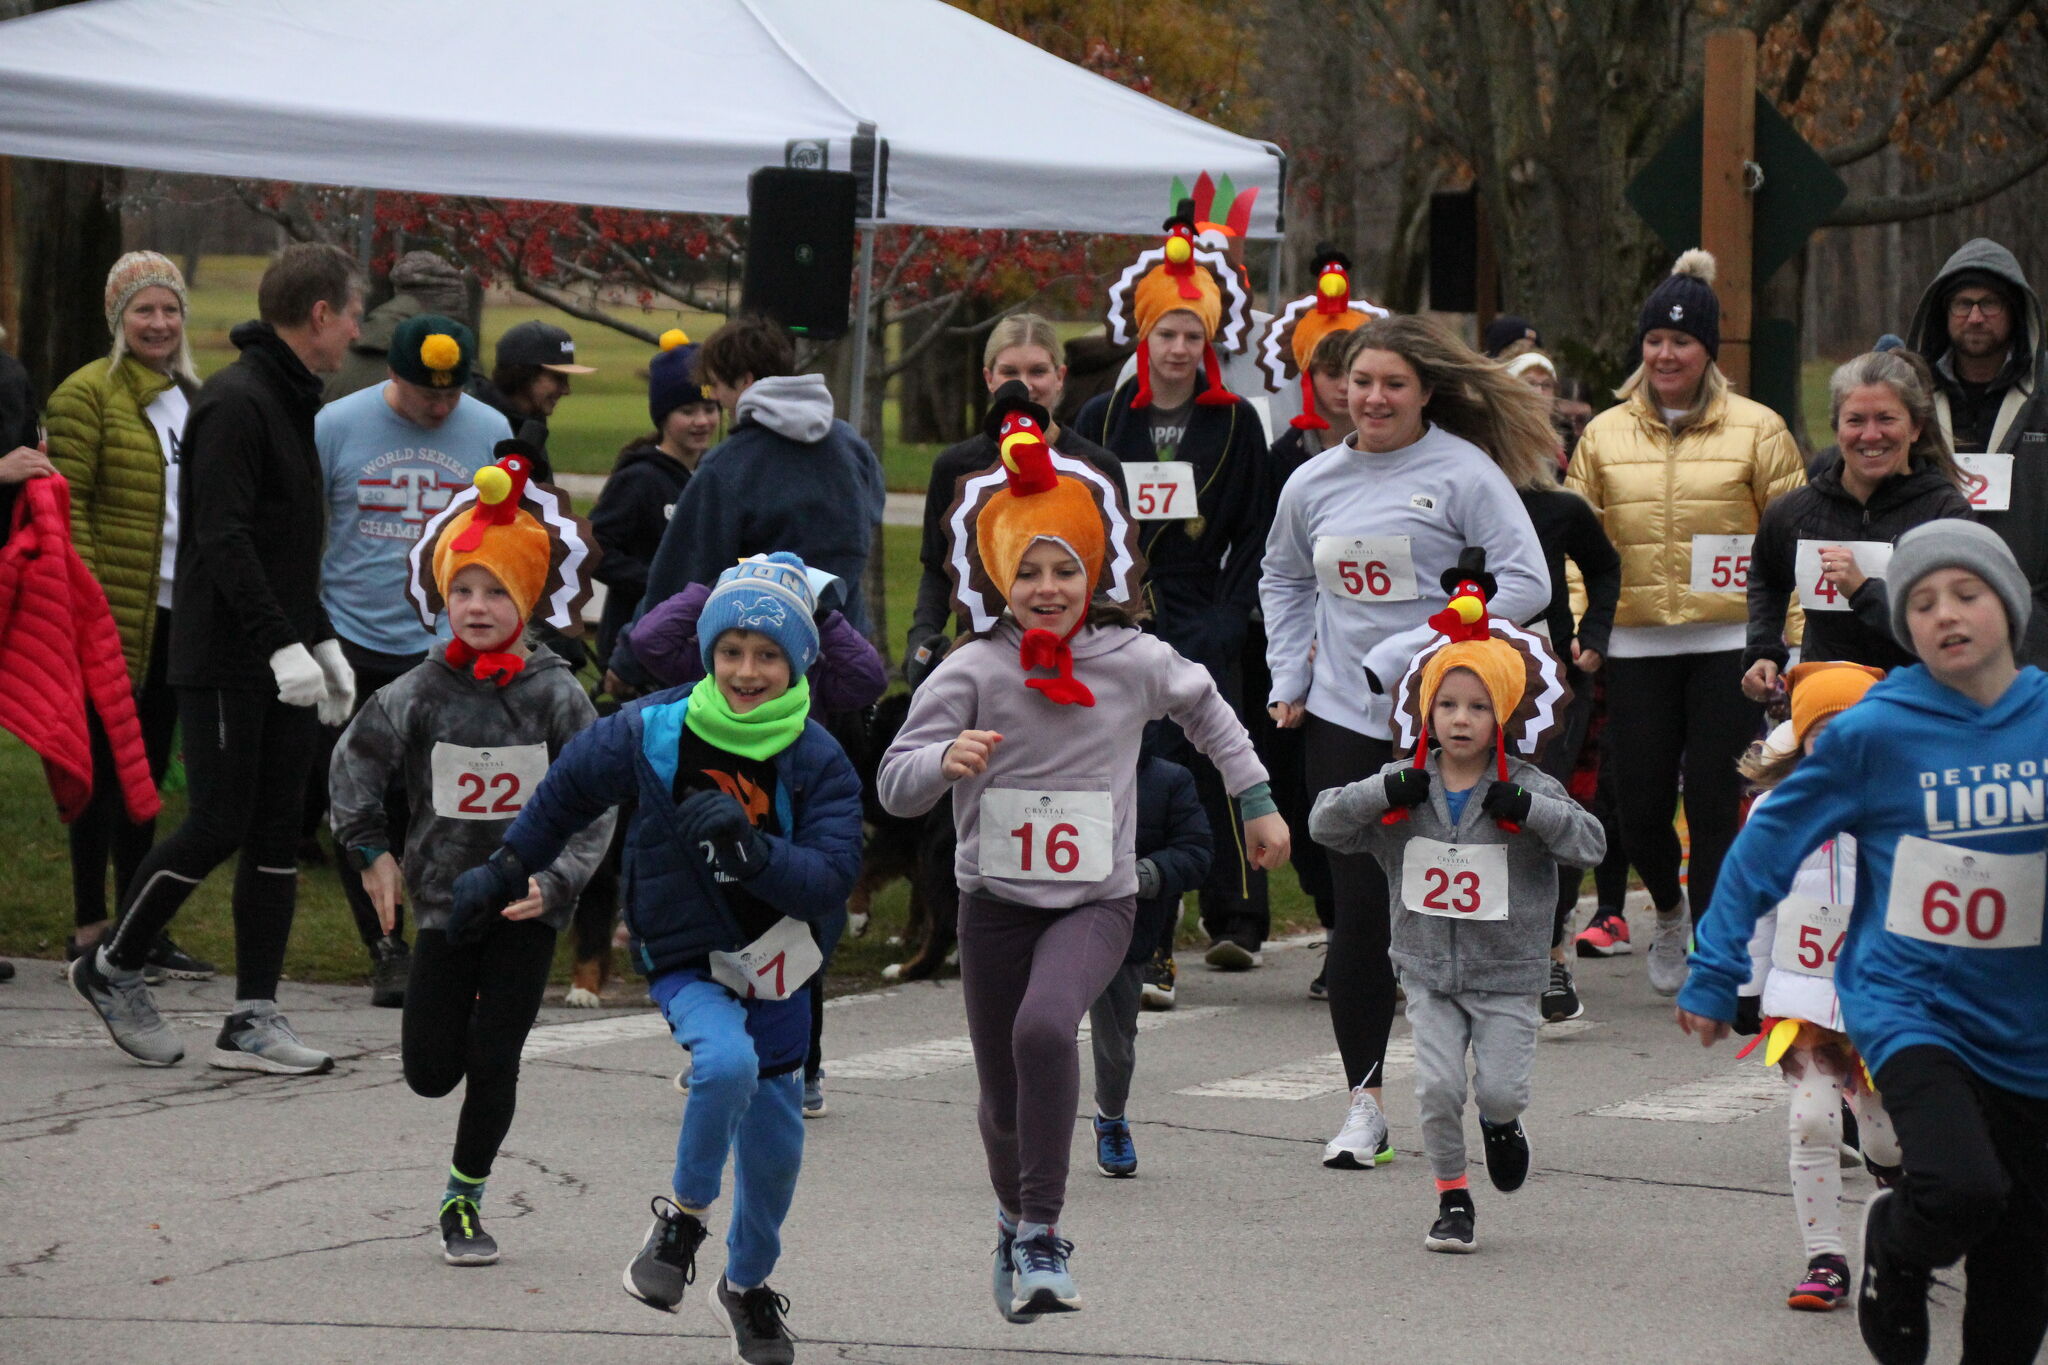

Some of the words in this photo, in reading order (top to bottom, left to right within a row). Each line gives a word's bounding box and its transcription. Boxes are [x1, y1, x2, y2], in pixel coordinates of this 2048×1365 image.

[362, 447, 415, 477] WORLD
[418, 447, 470, 480] SERIES
[1137, 482, 1178, 515] 57
[1967, 474, 1989, 504] 2
[1338, 560, 1392, 596] 56
[1711, 555, 1751, 588] 55
[1814, 570, 1838, 604] 4
[457, 772, 522, 813] 22
[1024, 806, 1065, 815] CRYSTAL
[1010, 822, 1080, 874] 16
[1436, 855, 1471, 865] CRYSTAL
[1423, 867, 1481, 914] 23
[1922, 880, 2007, 941] 60
[747, 949, 786, 998] 7
